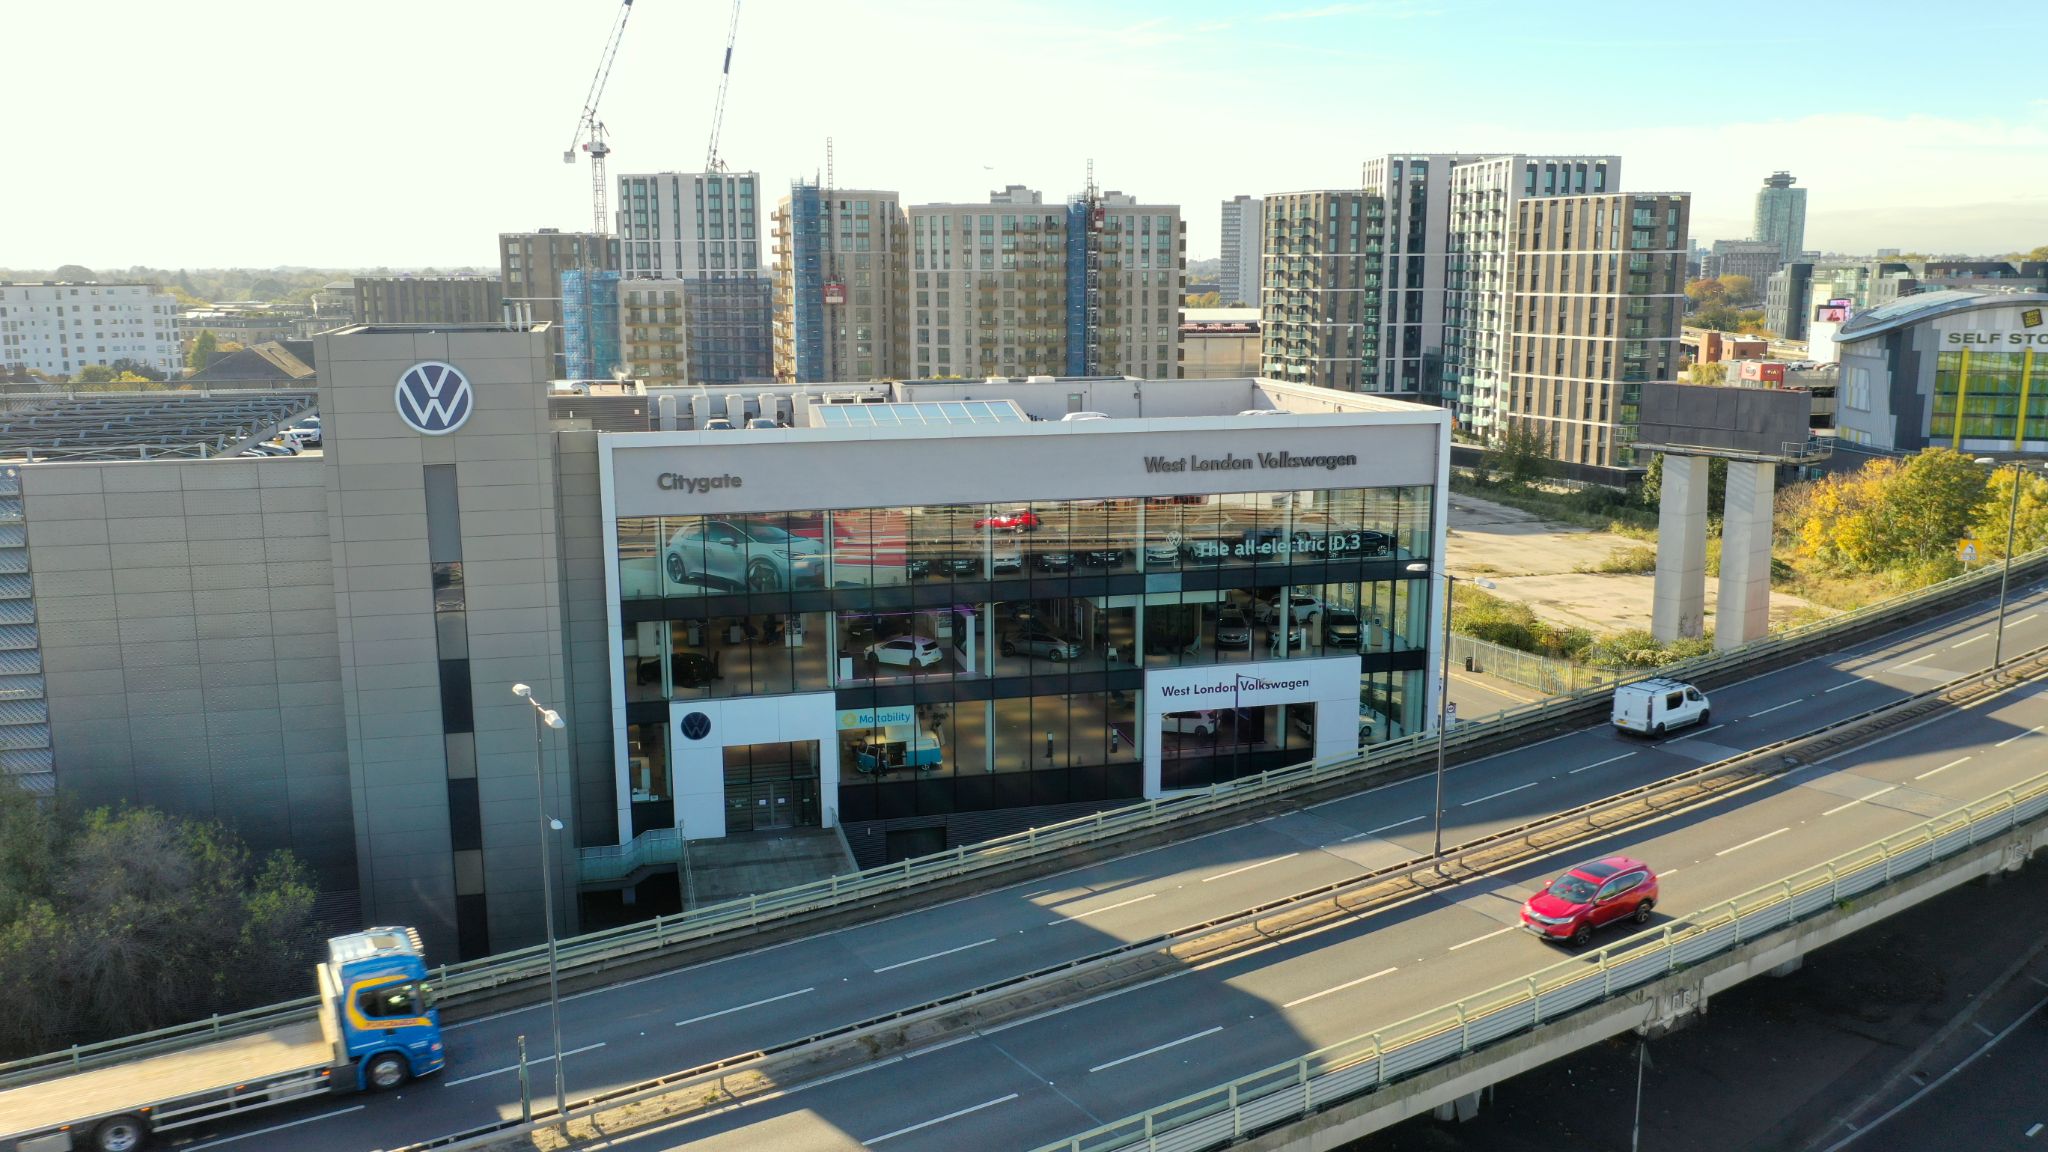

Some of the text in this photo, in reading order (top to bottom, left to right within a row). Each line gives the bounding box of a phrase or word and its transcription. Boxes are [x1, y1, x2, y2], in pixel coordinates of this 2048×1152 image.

[1948, 332, 2048, 345] SELF STO
[398, 363, 470, 430] VW
[1144, 450, 1358, 473] West London Volkswagen
[657, 472, 743, 494] Citygate
[1197, 534, 1361, 557] The all-electric ID.3
[1161, 679, 1309, 697] West London Volkswagen
[859, 712, 911, 724] Motability
